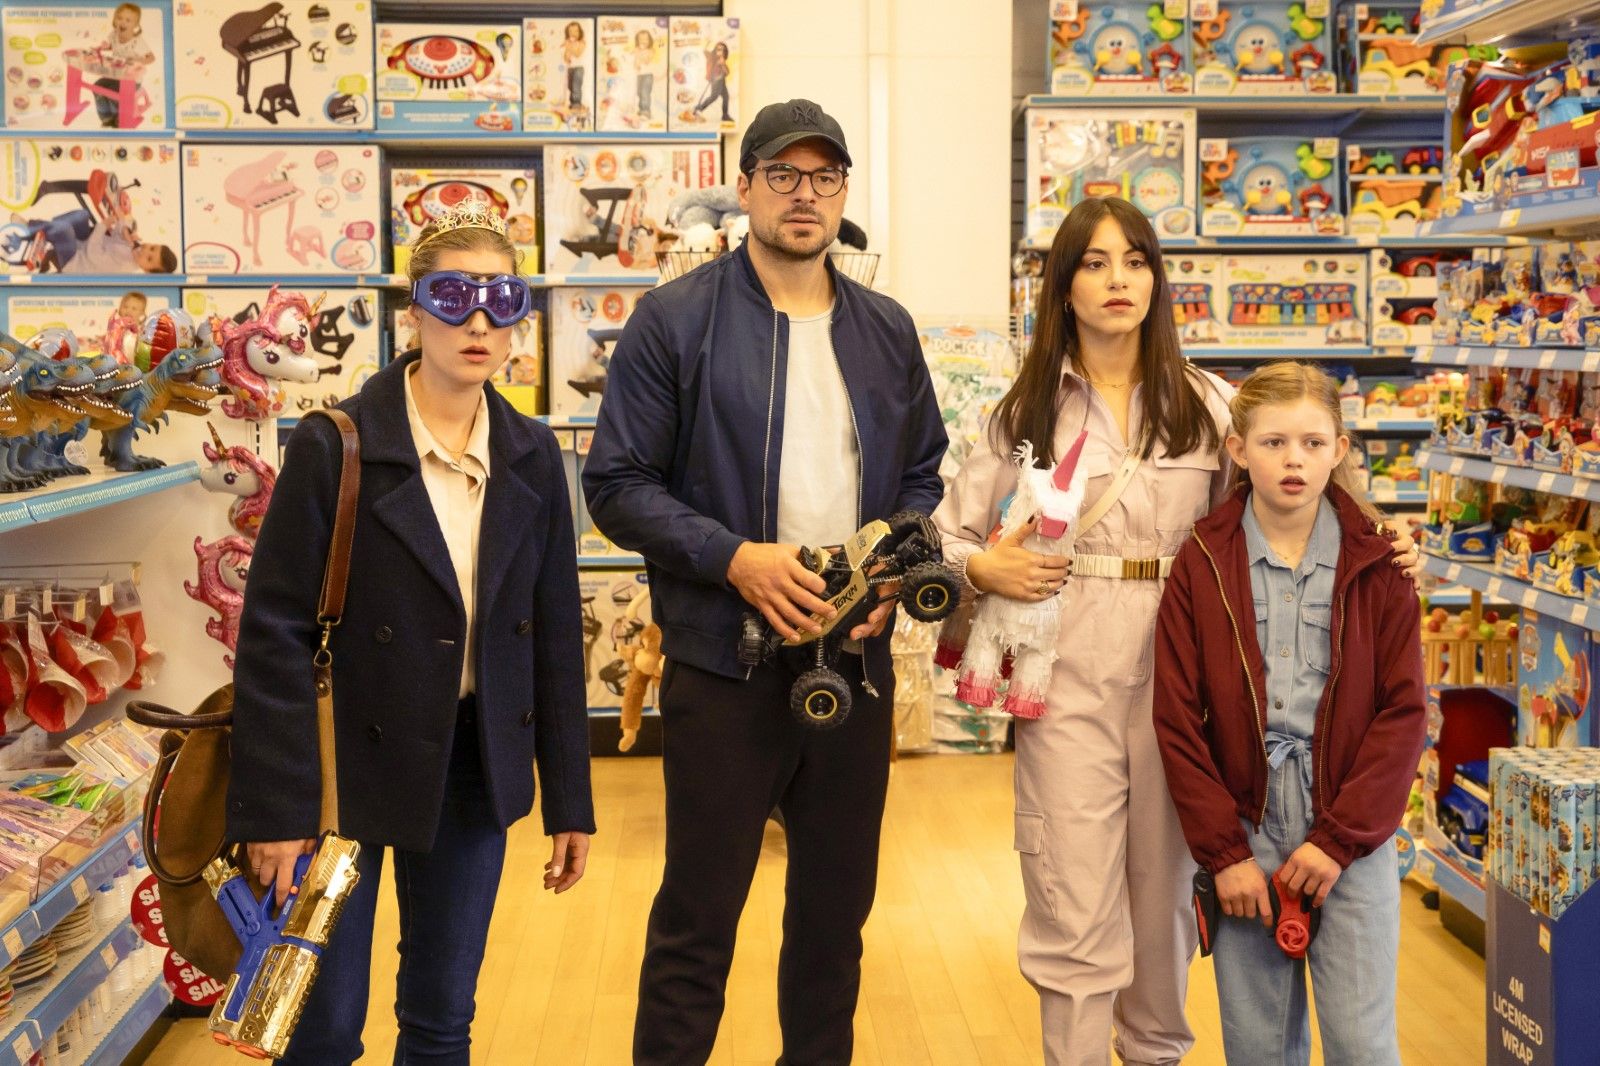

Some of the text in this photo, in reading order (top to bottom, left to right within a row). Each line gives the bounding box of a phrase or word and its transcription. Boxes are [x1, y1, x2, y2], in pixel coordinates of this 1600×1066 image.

[792, 105, 818, 126] NY
[180, 964, 207, 984] SA
[188, 977, 226, 1001] SAL
[1508, 976, 1525, 1003] 4M
[1492, 990, 1544, 1046] LICENSED
[1501, 1026, 1534, 1066] WRAP
